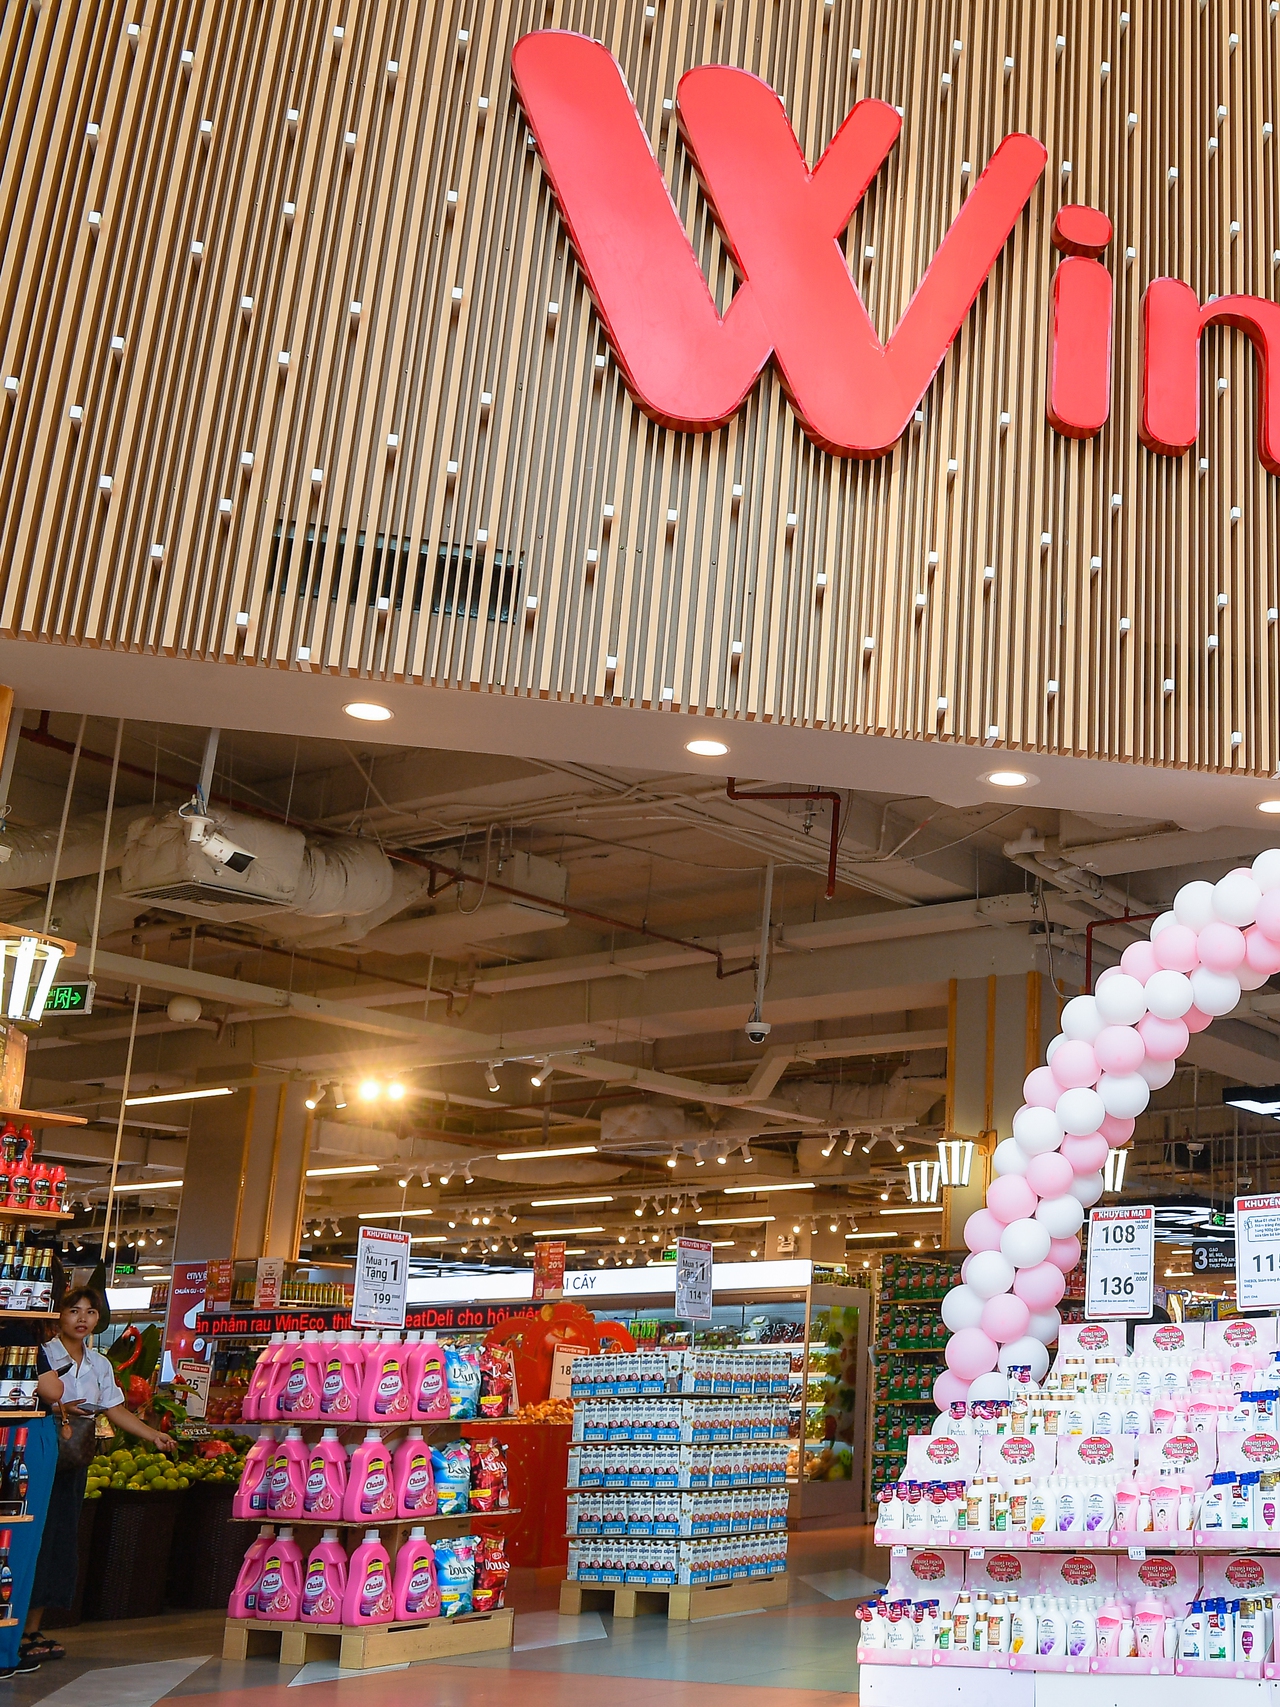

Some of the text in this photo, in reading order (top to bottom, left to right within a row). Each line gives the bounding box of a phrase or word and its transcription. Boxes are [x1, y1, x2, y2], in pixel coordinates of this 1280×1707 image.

[1102, 1225, 1135, 1244] 108
[366, 1255, 382, 1266] Mua
[1194, 1247, 1208, 1270] 3
[365, 1259, 399, 1282] Tặng 1
[572, 1273, 597, 1290] CÂY
[1100, 1276, 1134, 1295] 136
[373, 1292, 391, 1305] 199
[689, 1290, 702, 1300] 114
[212, 1314, 247, 1335] phẩm
[250, 1319, 272, 1332] rau
[405, 1308, 454, 1327] eatDeli
[457, 1307, 483, 1325] cho
[487, 1306, 509, 1324] hội
